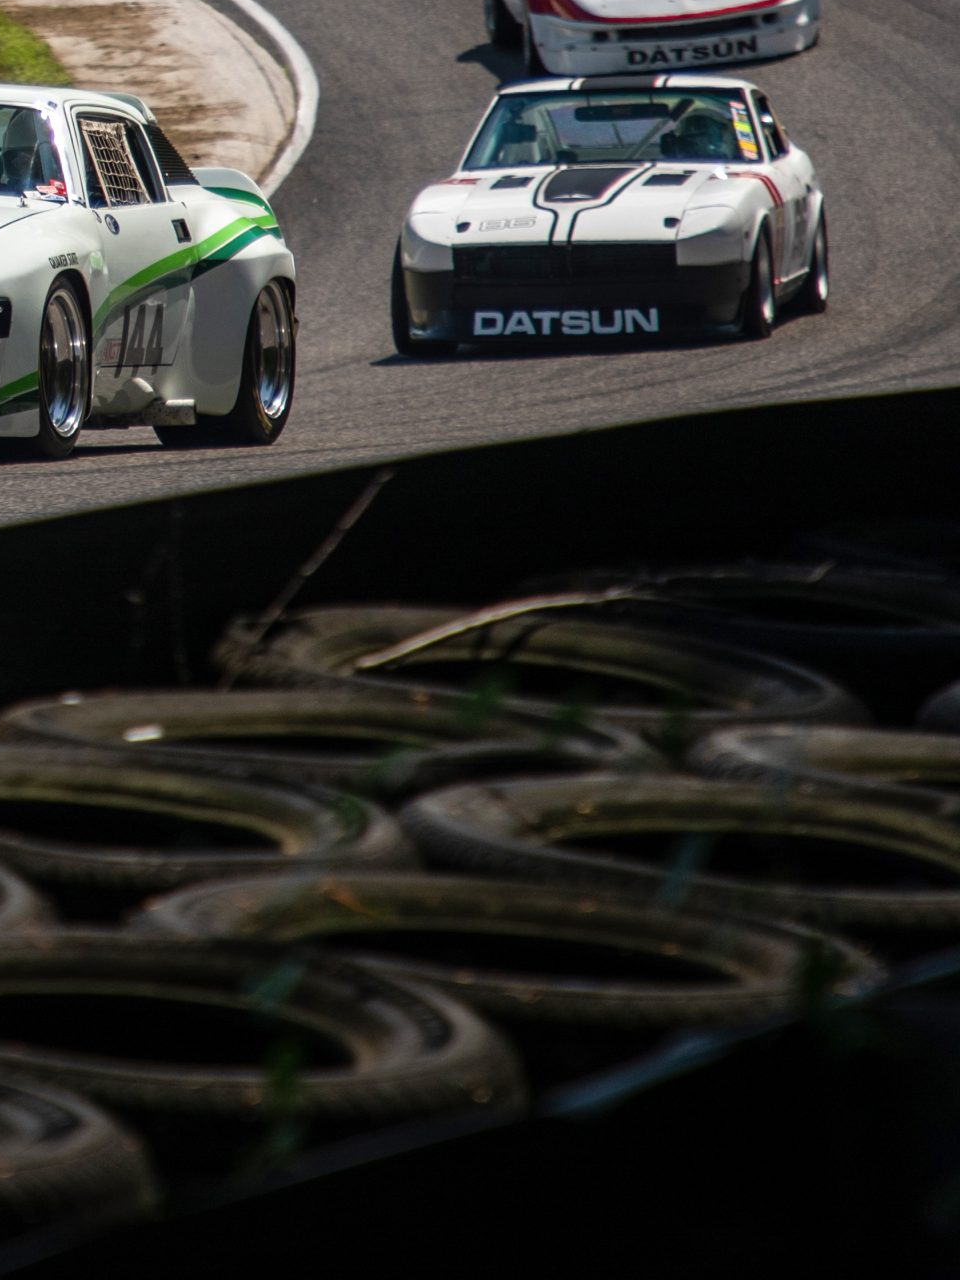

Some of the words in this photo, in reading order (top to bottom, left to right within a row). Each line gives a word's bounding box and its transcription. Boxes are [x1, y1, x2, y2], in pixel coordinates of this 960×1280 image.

[627, 35, 758, 66] DATSUN
[473, 308, 660, 336] DATSUN
[114, 304, 164, 379] 144
